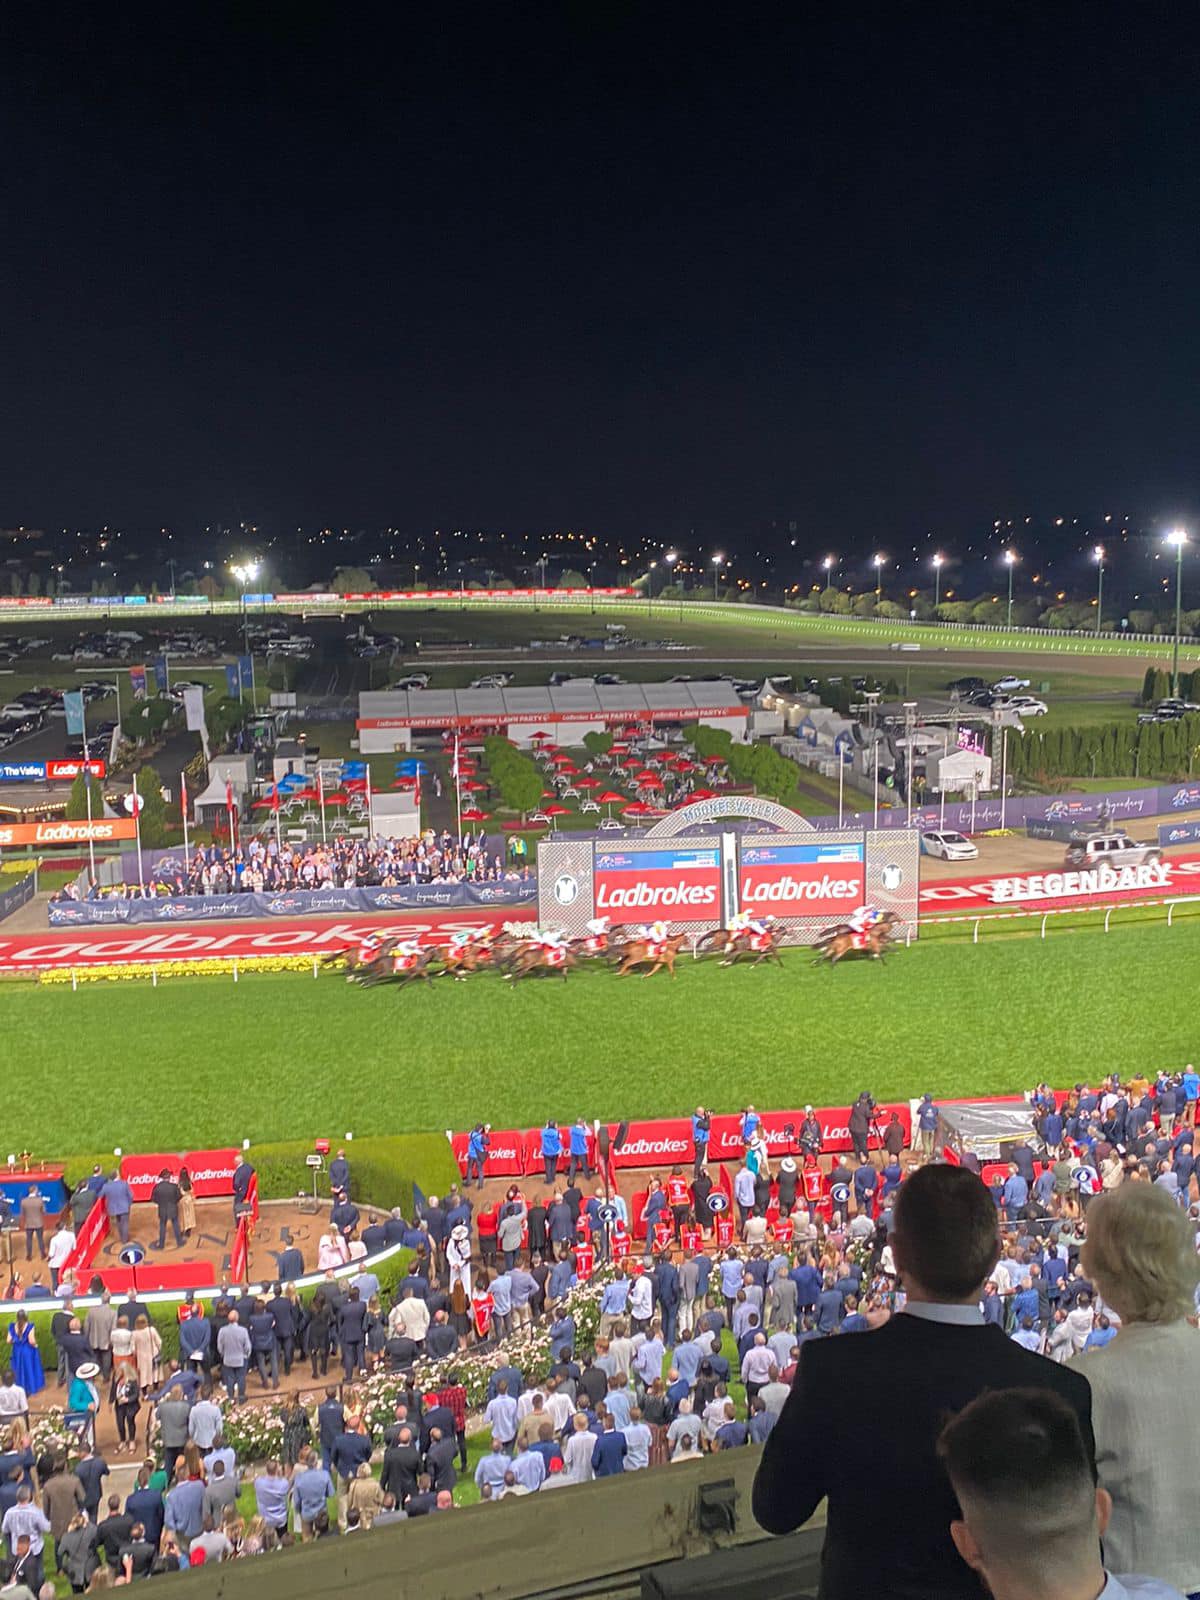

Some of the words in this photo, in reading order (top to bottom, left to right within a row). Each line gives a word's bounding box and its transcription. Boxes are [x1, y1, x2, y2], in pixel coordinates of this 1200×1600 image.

[520, 714, 543, 723] PARTY
[610, 710, 633, 720] PARTY
[700, 708, 722, 717] PARTY
[427, 717, 450, 726] PARTY
[20, 765, 44, 777] Valley
[682, 799, 731, 821] MOONEE
[735, 799, 778, 819] VALLEY
[36, 823, 113, 840] Ladbrokes
[596, 880, 717, 908] Ladbrokes
[742, 874, 861, 902] Ladbrokes
[0, 921, 492, 961] adbrokes
[458, 1147, 516, 1162] Larokes
[714, 1198, 723, 1210] 3
[604, 1209, 613, 1221] 2
[127, 1251, 136, 1264] 1
